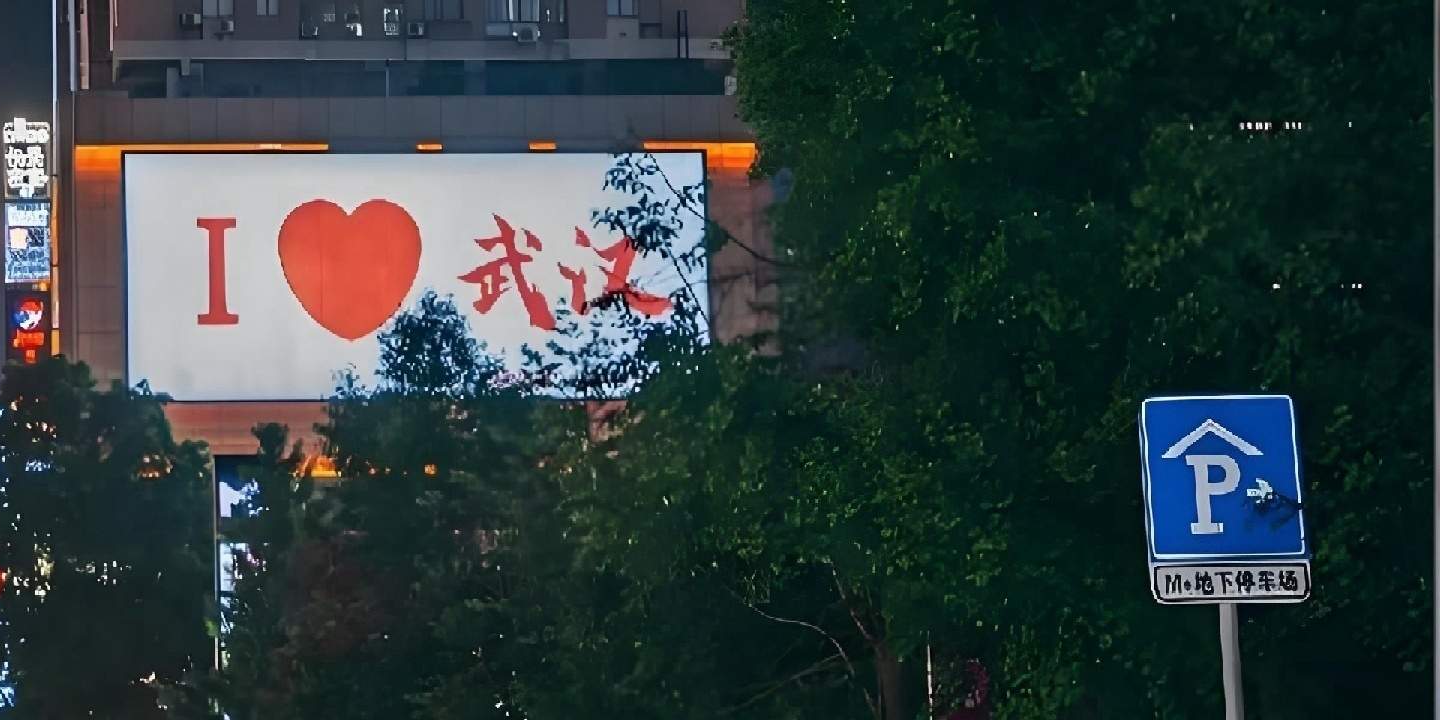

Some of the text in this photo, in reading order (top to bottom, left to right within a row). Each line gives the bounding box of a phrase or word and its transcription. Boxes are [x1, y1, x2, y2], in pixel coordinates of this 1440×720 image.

[197, 213, 672, 331] I 武汉
[1185, 454, 1241, 535] P
